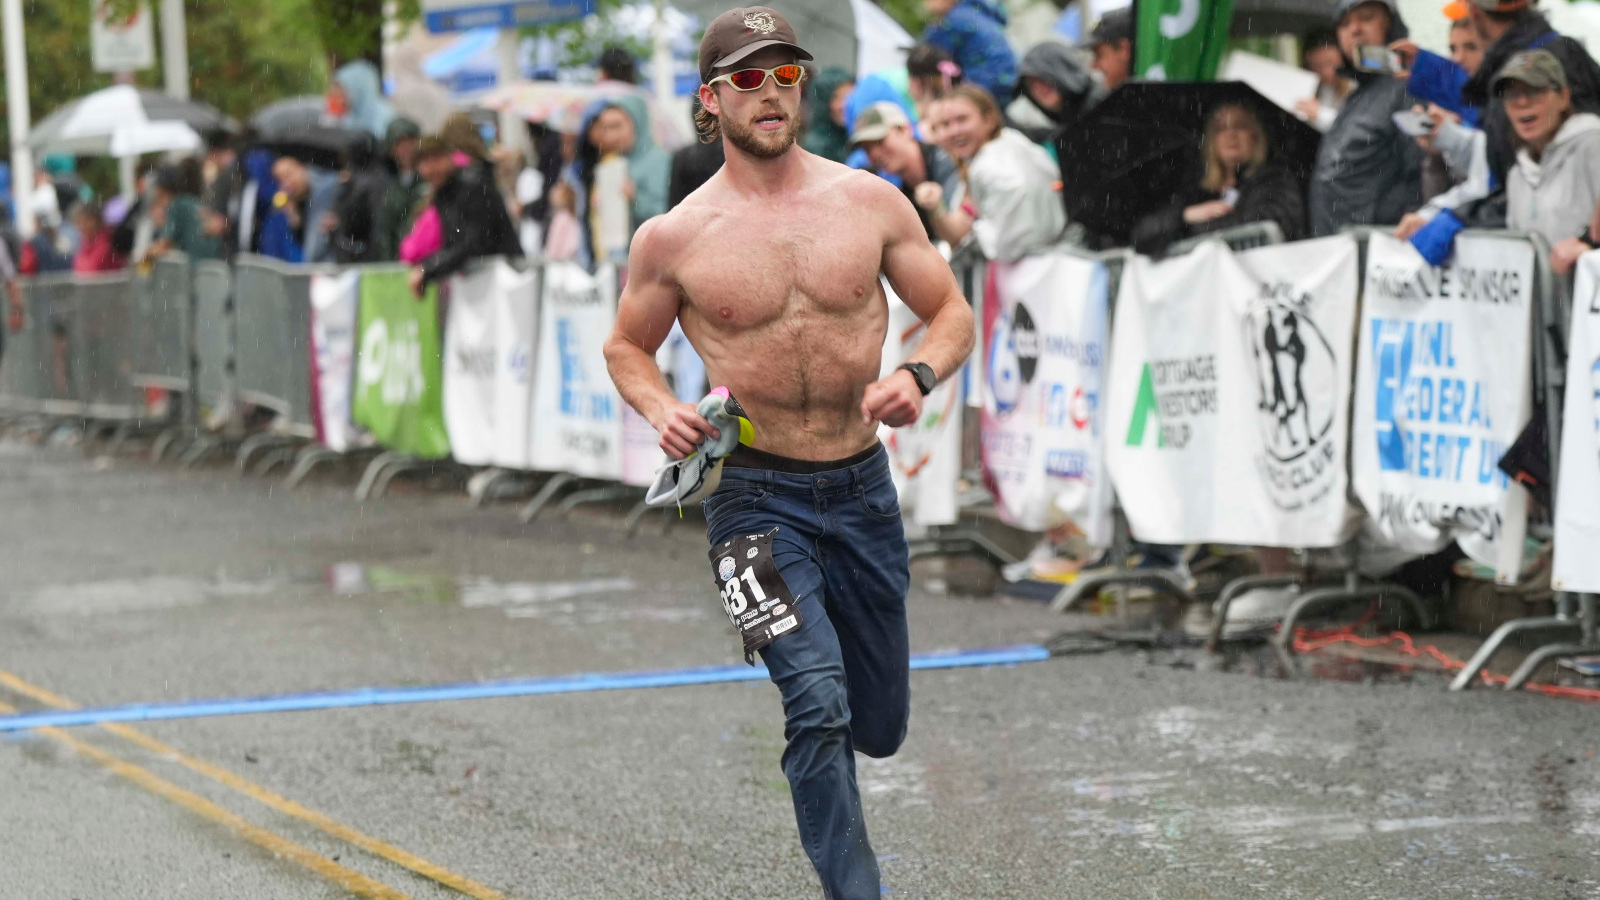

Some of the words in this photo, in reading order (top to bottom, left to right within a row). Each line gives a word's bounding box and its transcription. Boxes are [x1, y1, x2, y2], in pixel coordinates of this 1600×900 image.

[1152, 354, 1217, 385] ORTGAGE
[1406, 375, 1491, 429] EDERAL
[1405, 430, 1471, 482] REDIT
